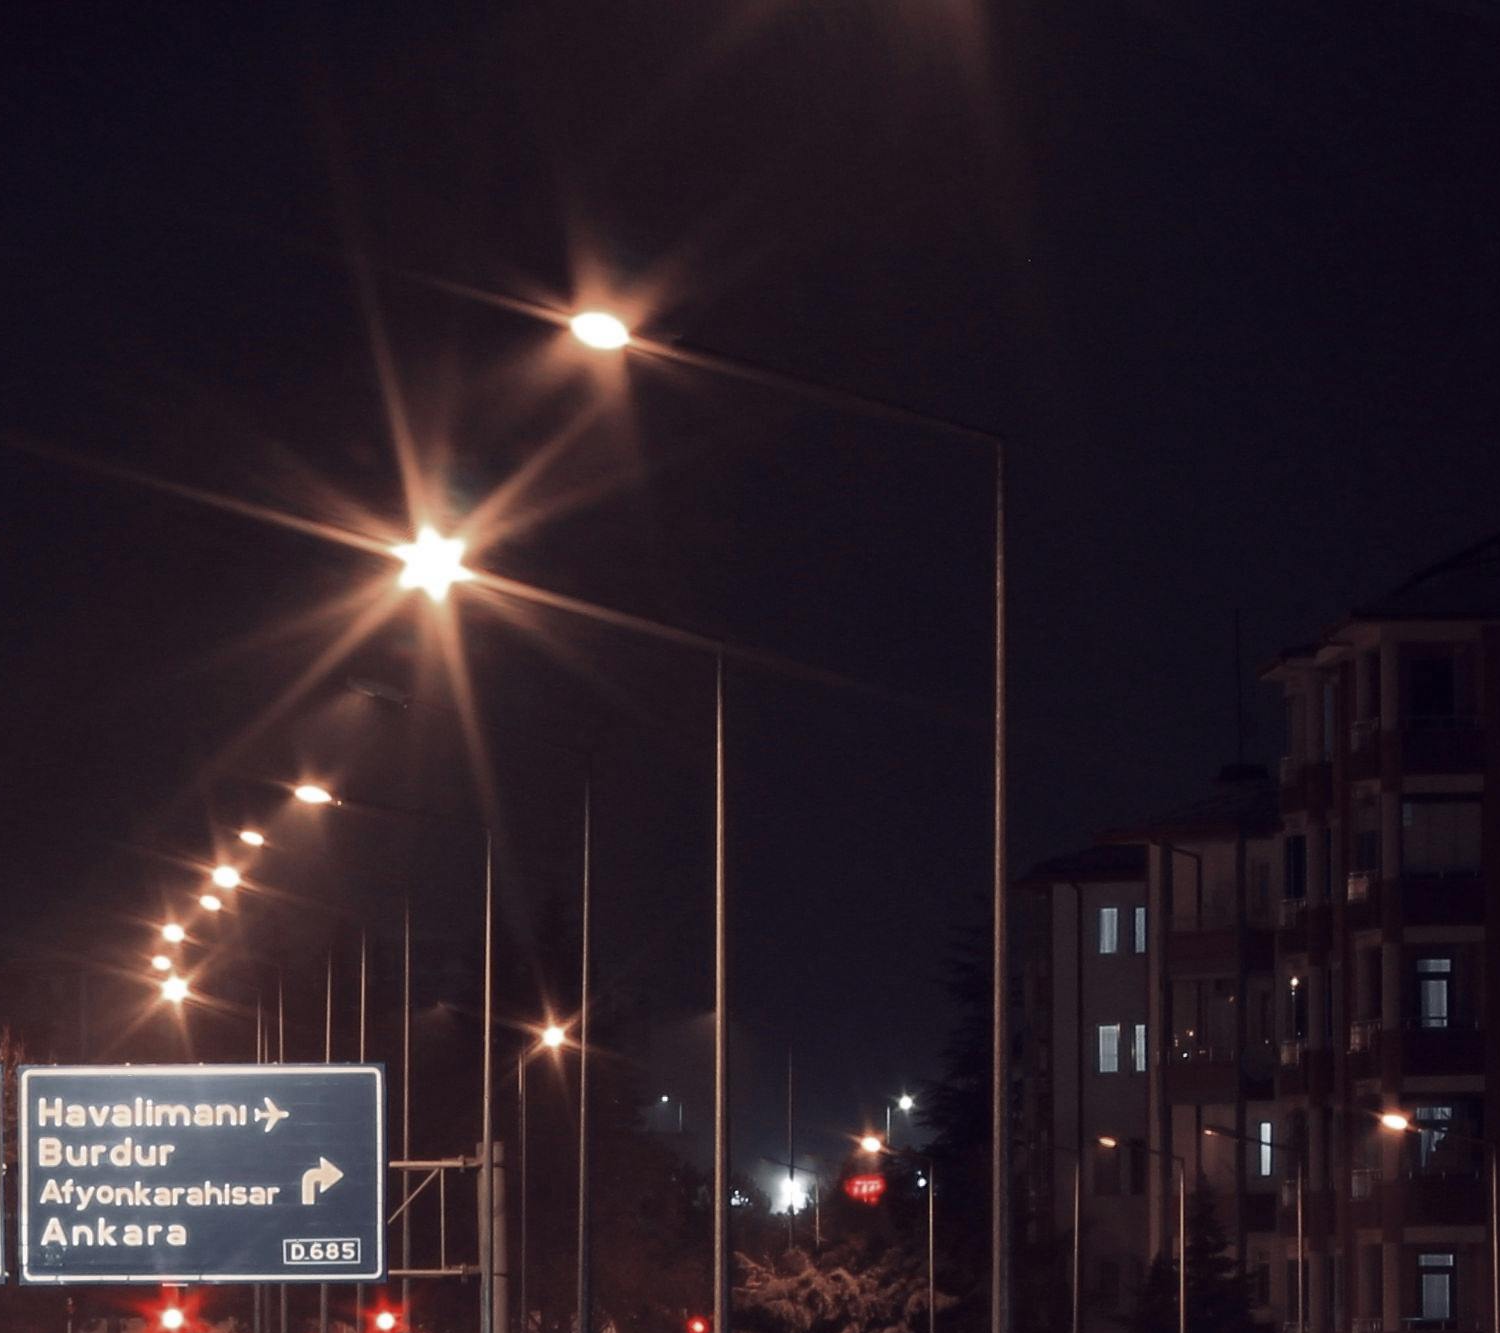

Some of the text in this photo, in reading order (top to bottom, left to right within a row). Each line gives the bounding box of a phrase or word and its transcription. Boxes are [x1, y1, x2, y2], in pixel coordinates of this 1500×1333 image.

[38, 1097, 247, 1127] Havalimanı
[38, 1137, 175, 1167] Burdur
[39, 1179, 280, 1210] Afyonkarahisar
[40, 1217, 187, 1246] Ankara
[291, 1242, 355, 1261] D.685
